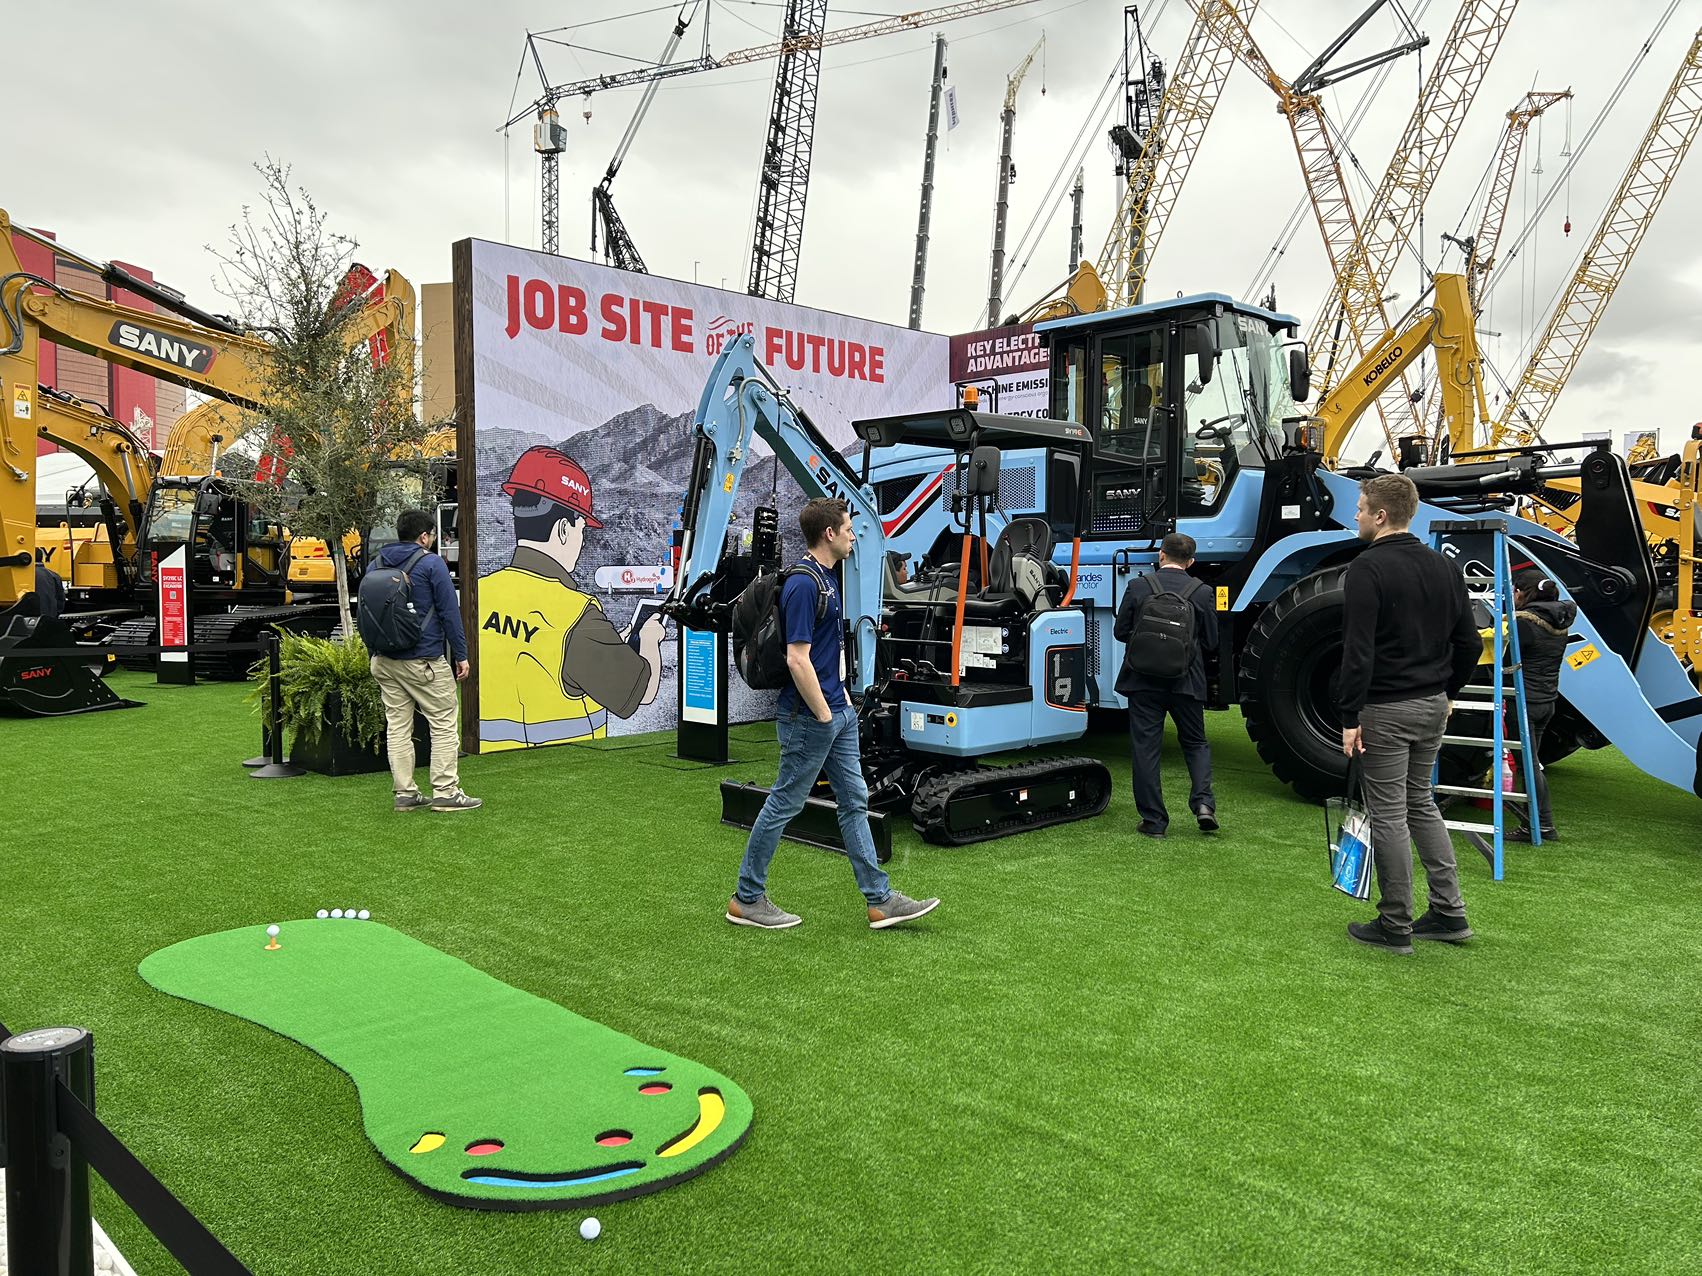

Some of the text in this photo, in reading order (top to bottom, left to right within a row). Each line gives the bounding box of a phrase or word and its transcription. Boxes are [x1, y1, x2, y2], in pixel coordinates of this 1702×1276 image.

[505, 275, 588, 339] JOB
[601, 294, 694, 353] SITE
[765, 326, 884, 383] FUTURE
[119, 324, 201, 368] SANY
[967, 340, 993, 358] KEY
[1363, 346, 1403, 386] KOBELCO
[561, 476, 589, 496] SANY
[1106, 488, 1141, 499] SANY
[482, 611, 540, 643] ANY
[21, 668, 51, 680] SANY
